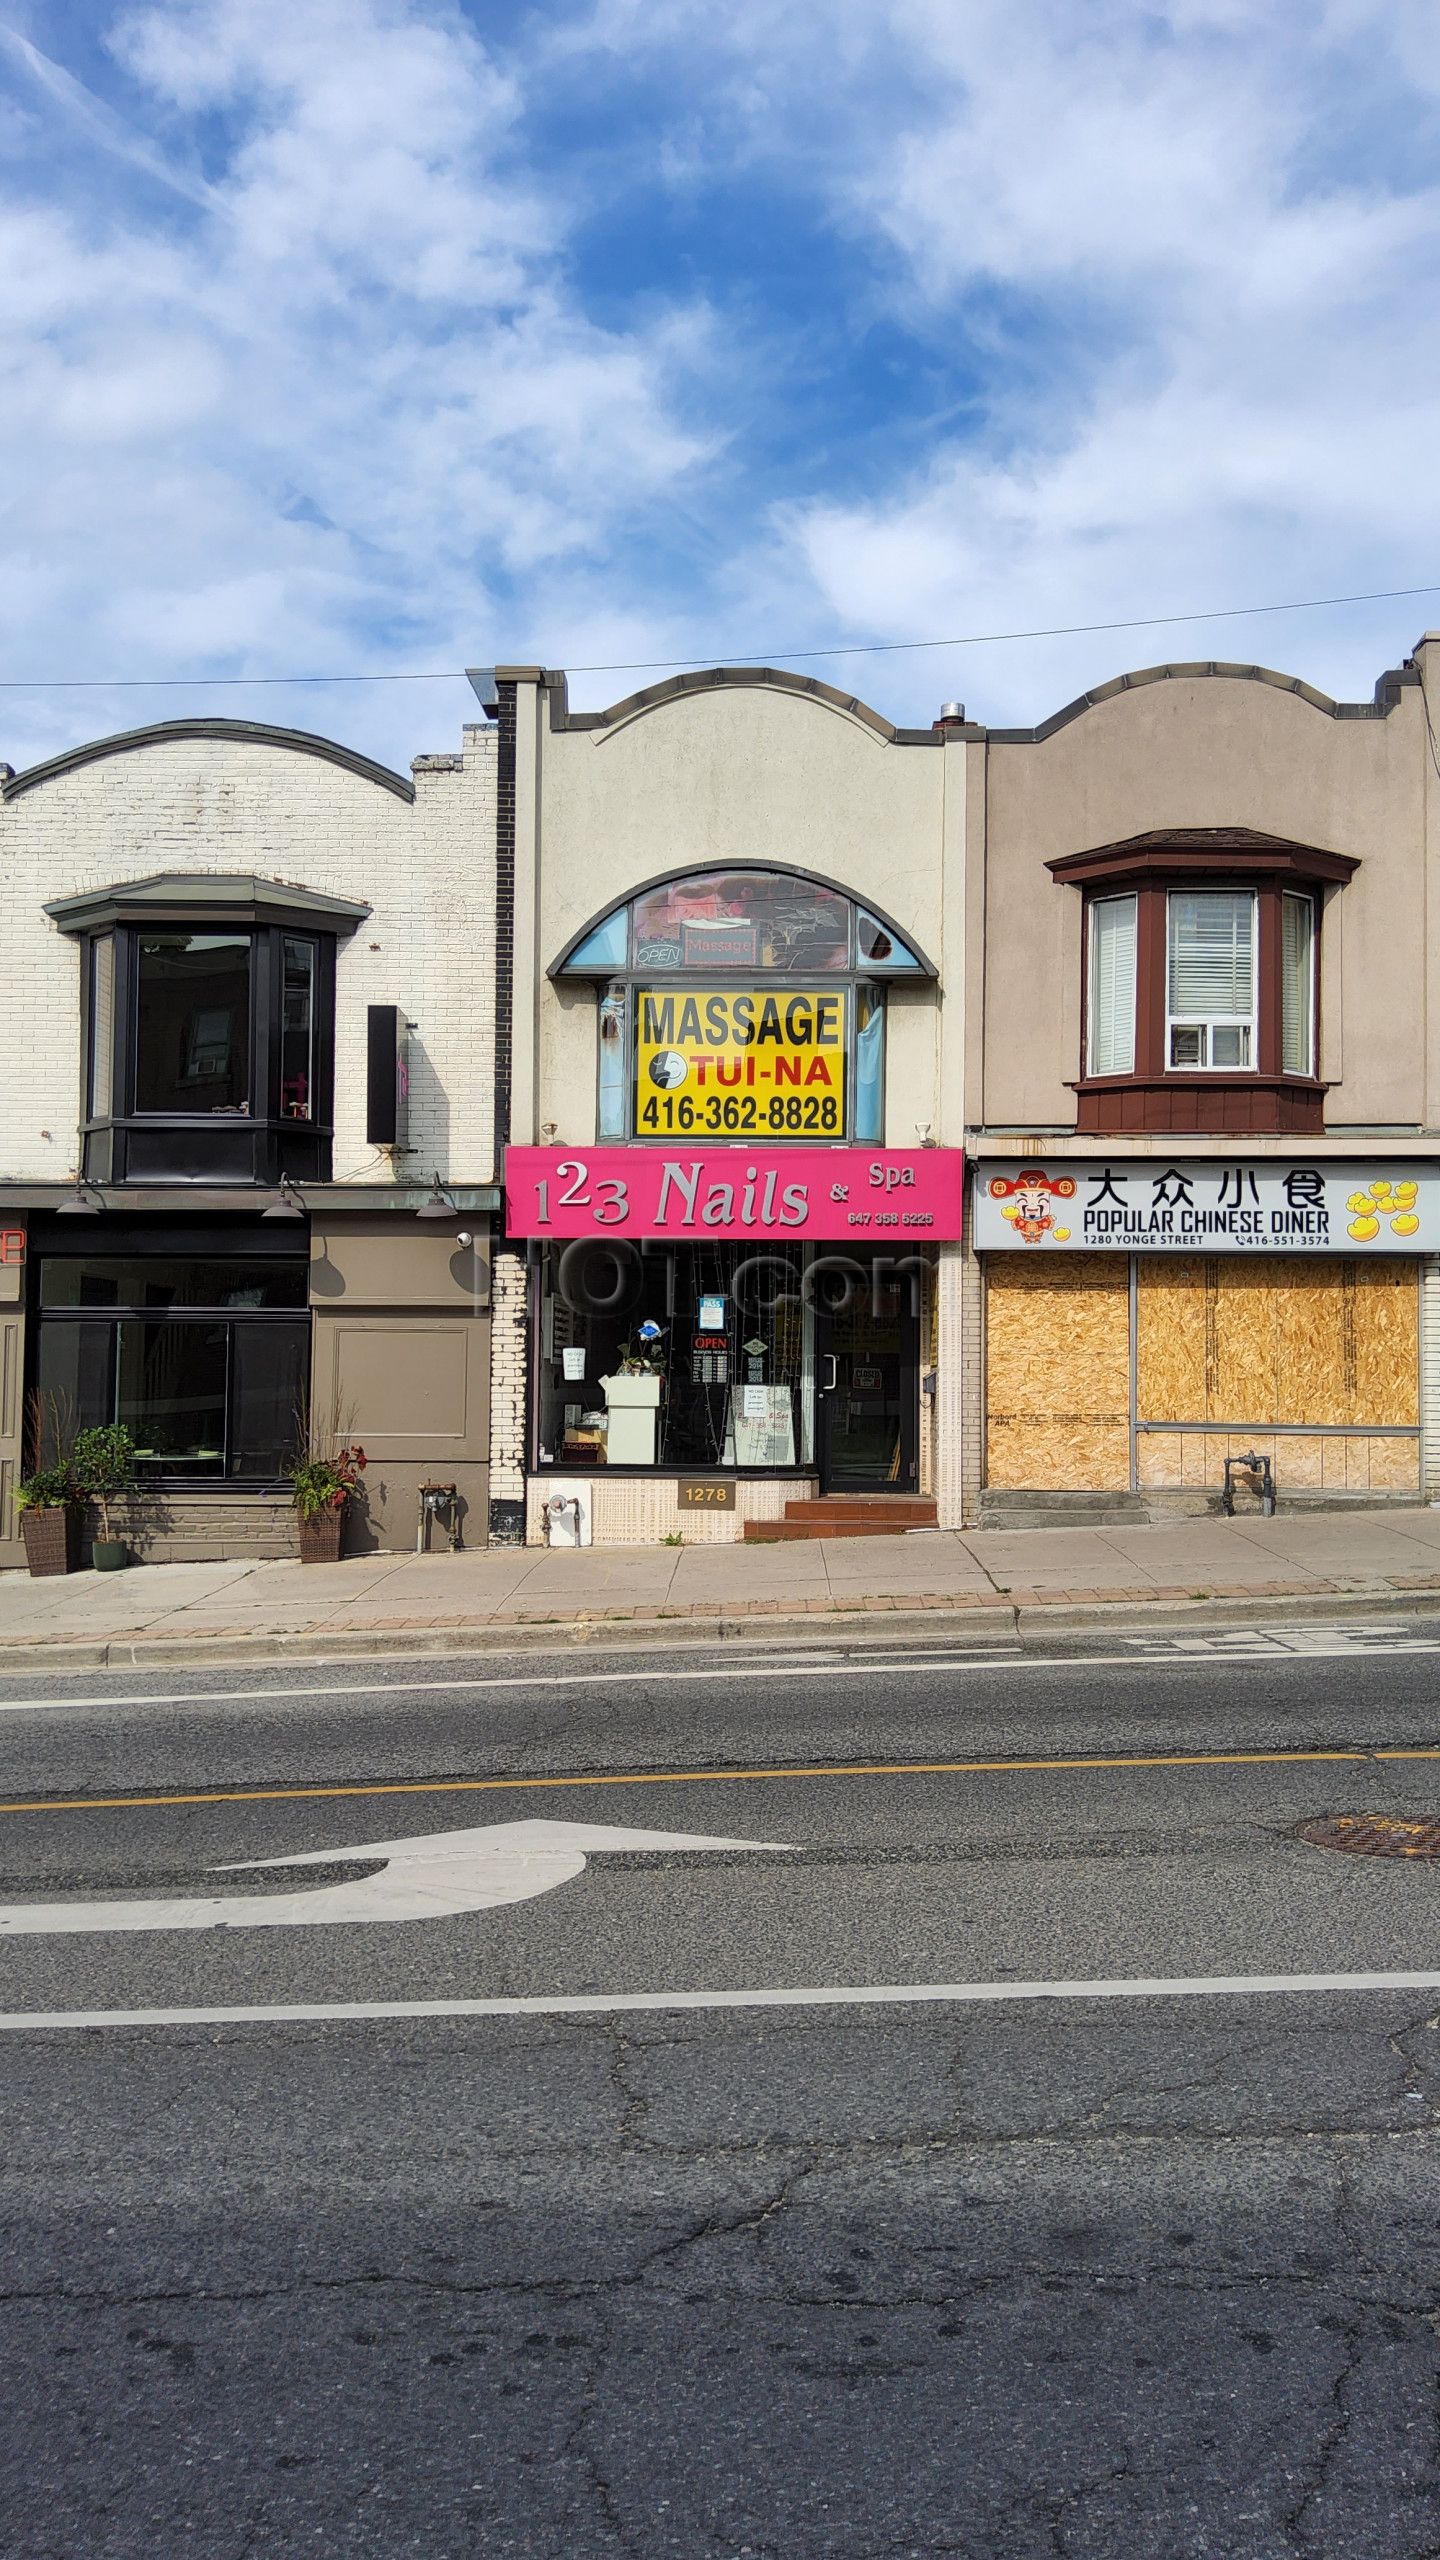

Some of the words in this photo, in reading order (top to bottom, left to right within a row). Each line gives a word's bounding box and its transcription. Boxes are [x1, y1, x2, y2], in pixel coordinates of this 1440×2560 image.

[687, 940, 751, 953] Massage
[638, 948, 680, 963] OPEN
[643, 996, 839, 1046] MASSAGE
[689, 1055, 832, 1087] TUI-NA
[643, 1095, 837, 1130] 416-362-8828
[534, 1161, 630, 1225] 123
[653, 1162, 809, 1226] Nails
[830, 1183, 849, 1202] &
[869, 1162, 915, 1191] Spa
[1087, 1168, 1325, 1209] 大众小食
[848, 1212, 871, 1225] 647
[875, 1212, 898, 1225] 358
[902, 1212, 934, 1225] 5225
[1084, 1210, 1173, 1233] POPULAR
[1181, 1210, 1264, 1233] CHINESE
[1271, 1211, 1330, 1233] DINER
[1084, 1235, 1112, 1245] 1280
[1115, 1235, 1156, 1245] YONGE
[1160, 1235, 1203, 1245] STREET
[1246, 1235, 1330, 1246] 416-551-3574
[695, 1338, 727, 1349] OPEN
[685, 1488, 727, 1502] 1278
